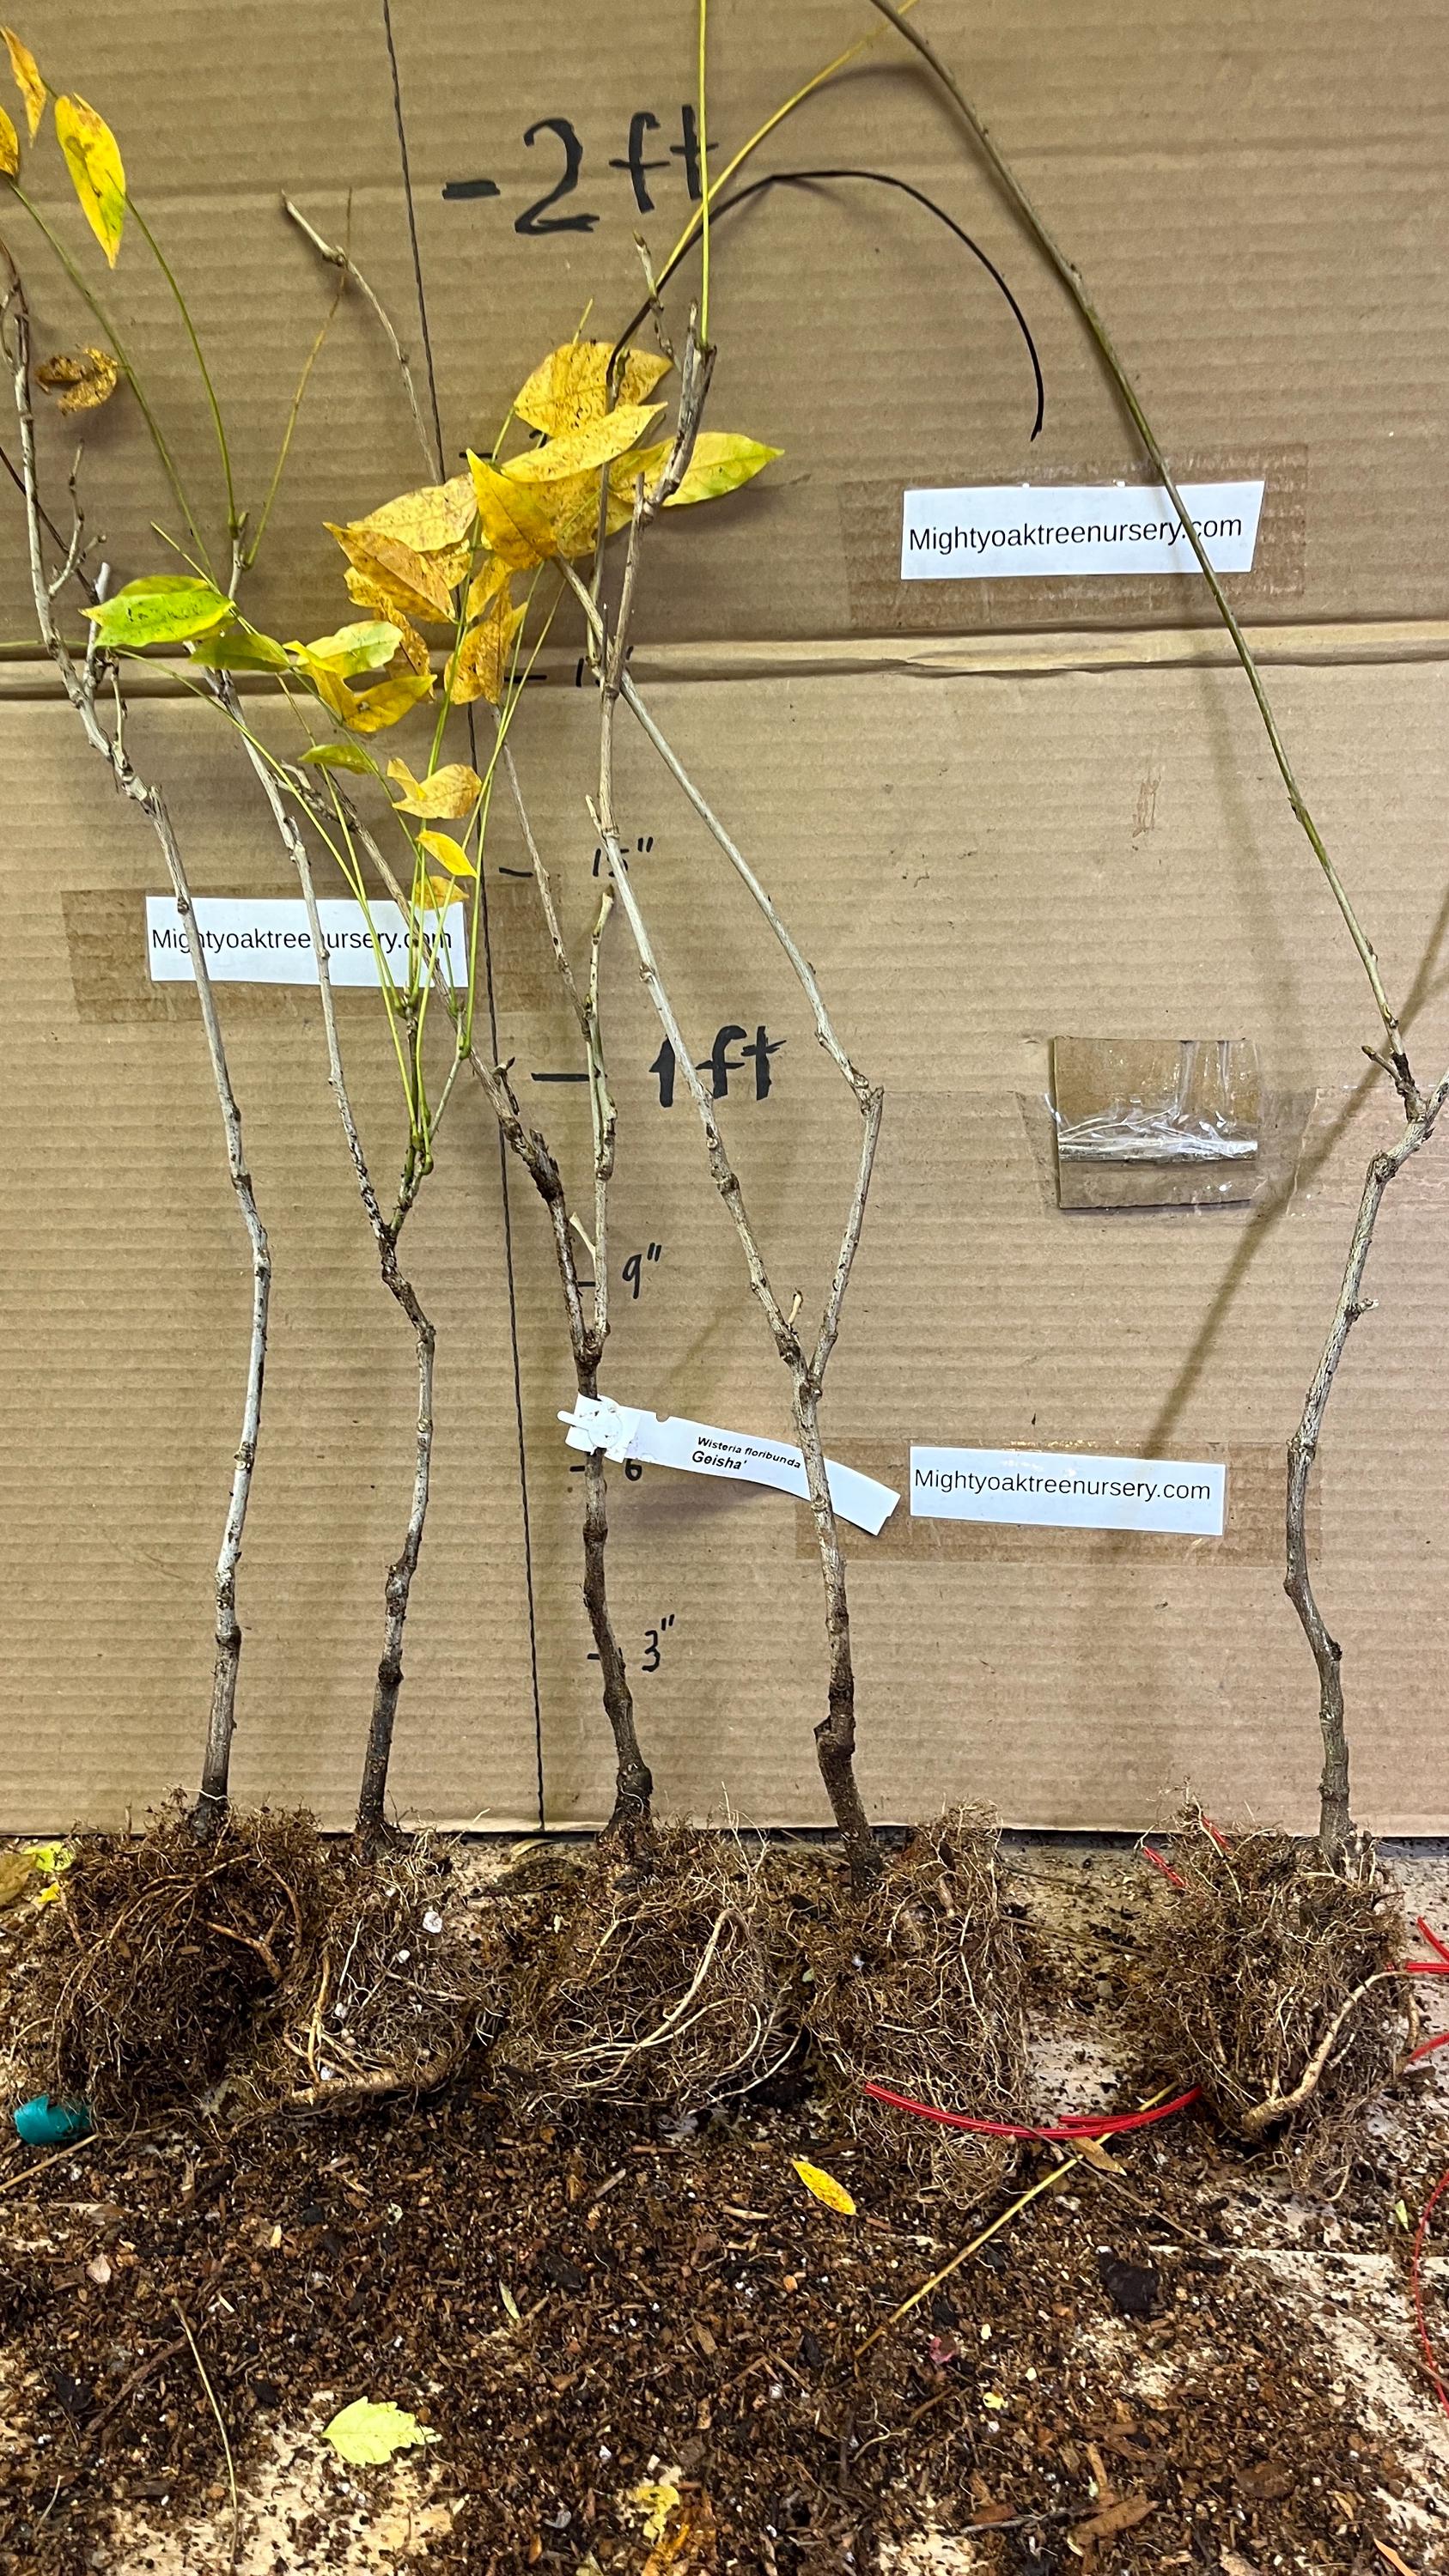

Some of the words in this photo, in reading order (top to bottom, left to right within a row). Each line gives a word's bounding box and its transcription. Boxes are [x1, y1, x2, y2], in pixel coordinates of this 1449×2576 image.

[152, 927, 452, 954] Migtyoaktreeursery.cm
[697, 1436, 742, 1455] Wisteria
[744, 1447, 801, 1469] floribunda
[914, 1468, 1211, 1503] Mightyoaktreenursery.com
